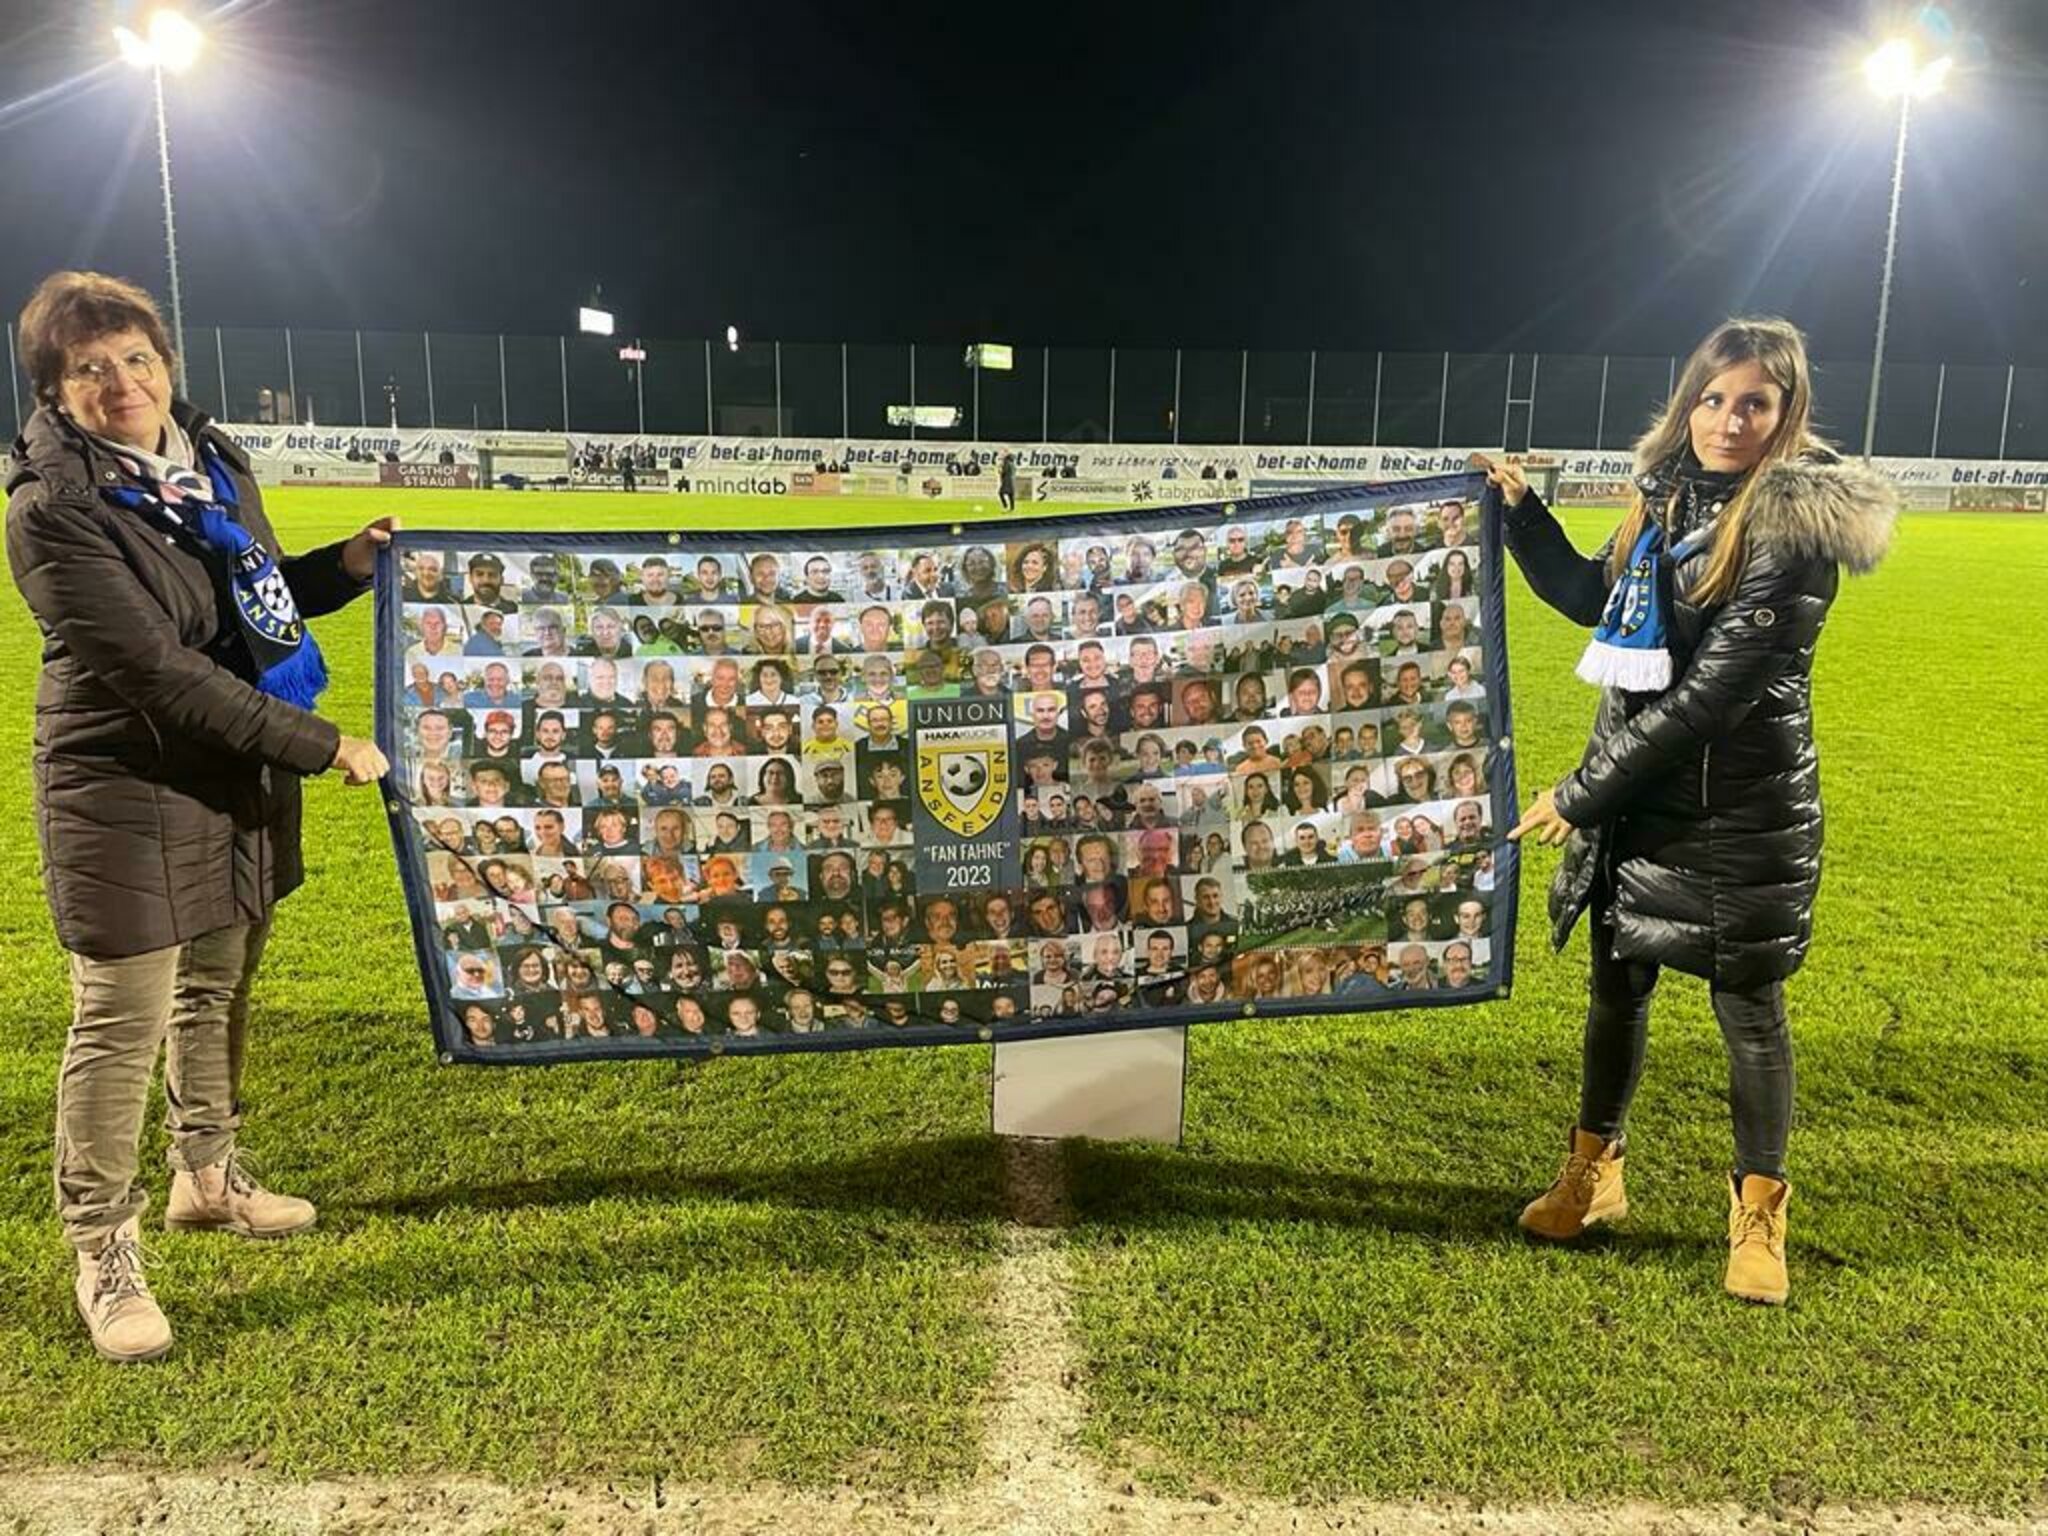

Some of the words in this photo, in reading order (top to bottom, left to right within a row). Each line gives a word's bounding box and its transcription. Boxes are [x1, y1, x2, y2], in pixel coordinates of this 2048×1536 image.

[286, 434, 400, 451] bet-at-home
[711, 444, 823, 462] bet-at-home
[844, 447, 957, 464] bet-at-home
[1256, 453, 1368, 471] bet-at-home
[1380, 455, 1464, 472] bet-at-ho
[399, 465, 460, 477] GASTHOF
[1952, 467, 2048, 485] bet-at-hom
[695, 475, 787, 495] mindtab
[1158, 484, 1244, 500] tabgroup.at
[240, 590, 300, 639] ANSFE
[917, 703, 1004, 725] UNION
[920, 750, 1007, 833] ANSFELDEN
[924, 845, 957, 863] "FAN
[960, 842, 1011, 861] FAHNE"
[947, 865, 991, 887] 2023
